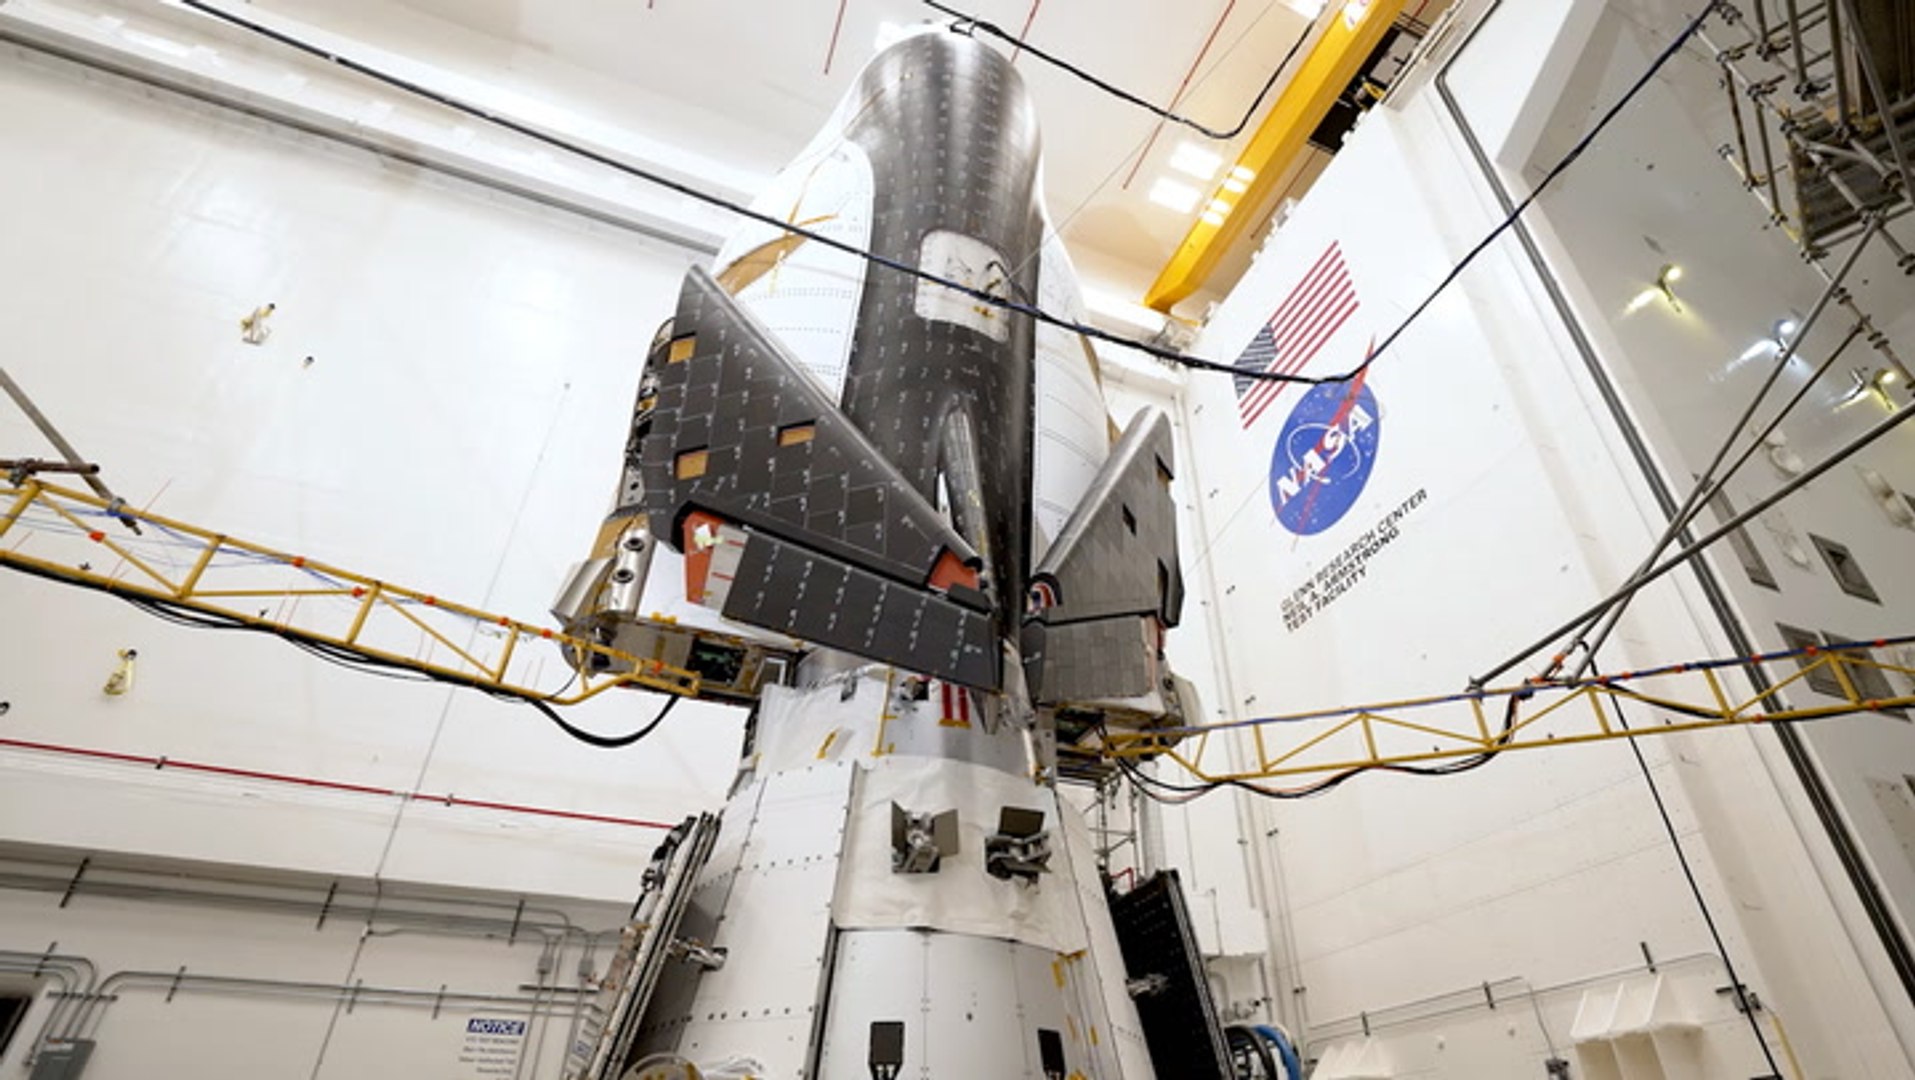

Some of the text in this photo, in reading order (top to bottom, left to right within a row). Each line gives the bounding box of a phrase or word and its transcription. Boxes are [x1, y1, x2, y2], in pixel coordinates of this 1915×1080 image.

[1277, 405, 1374, 505] NASA
[1281, 488, 1428, 611] GLENN RESEARCH CENTER
[1282, 601, 1308, 623] NEIL
[1323, 526, 1400, 592] ARMSTRONG
[1286, 566, 1367, 633] TEST FACILITY
[469, 1020, 522, 1034] NOTICE
